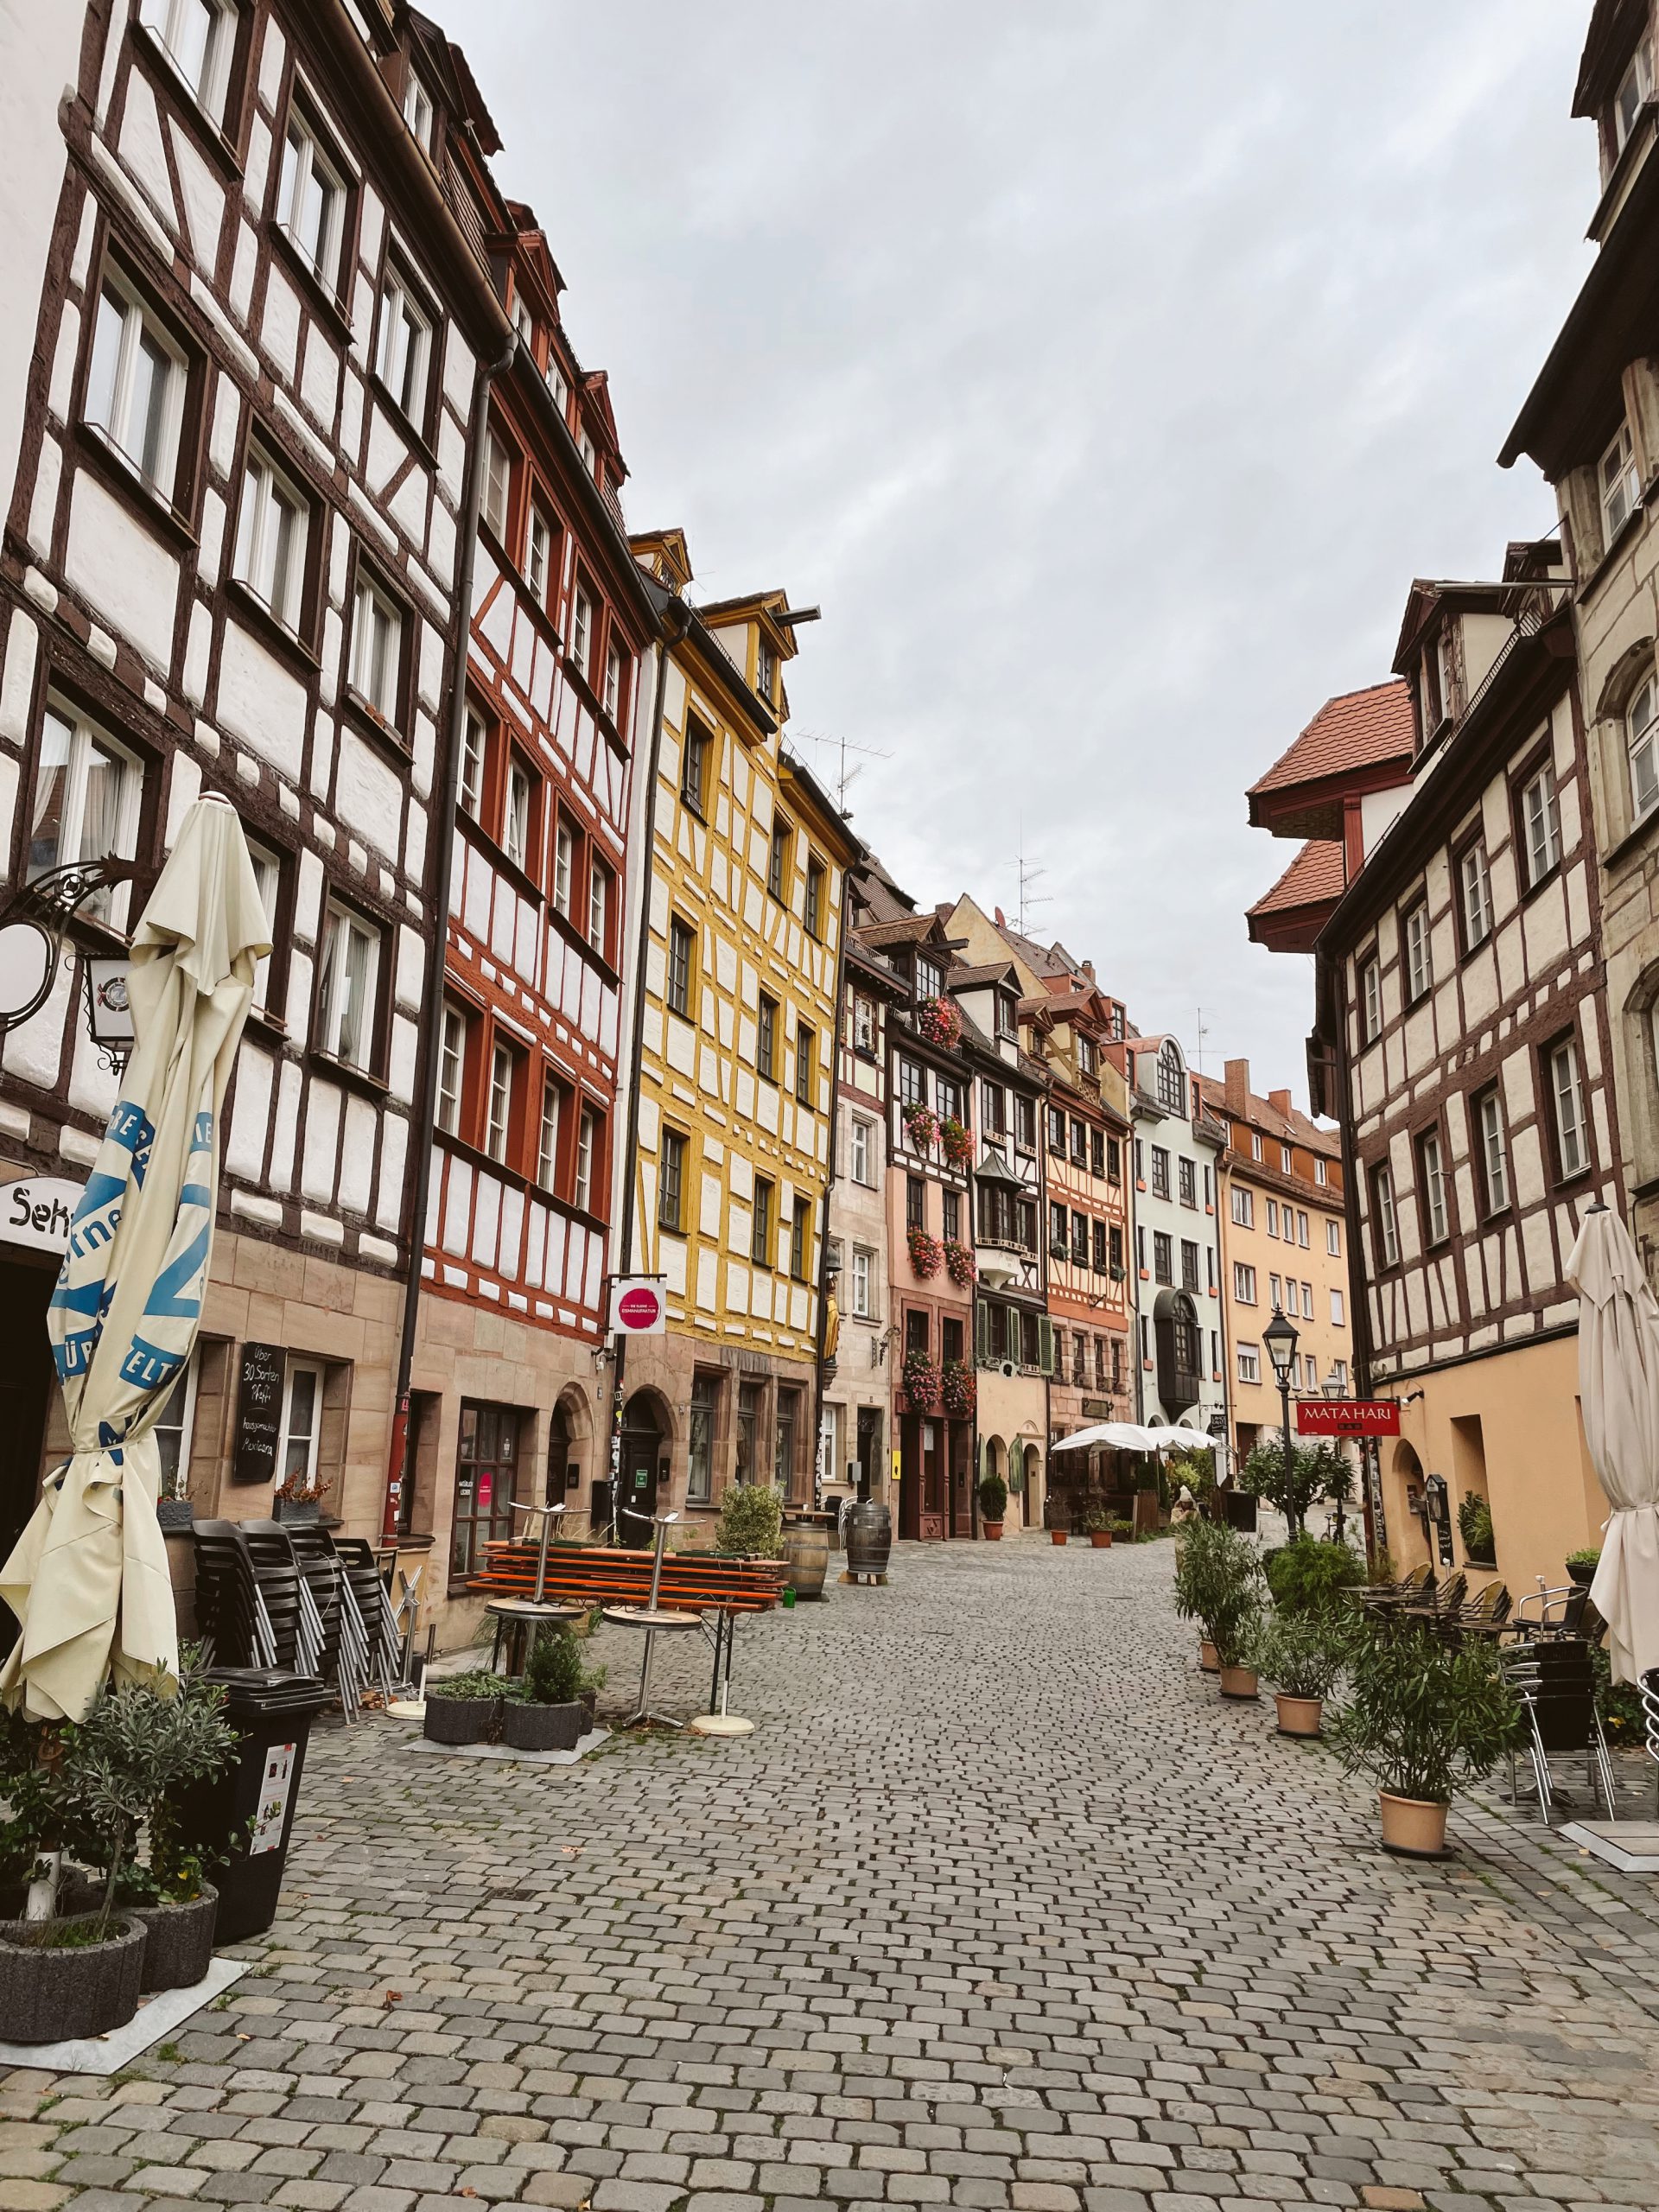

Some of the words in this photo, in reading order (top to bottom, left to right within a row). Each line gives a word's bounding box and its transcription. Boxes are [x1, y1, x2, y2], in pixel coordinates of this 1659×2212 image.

[9, 1186, 74, 1238] Sek
[254, 1345, 272, 1362] Über
[243, 1362, 256, 1382] 30
[255, 1364, 280, 1384] Sorten
[1304, 1408, 1351, 1420] MATA
[1353, 1408, 1391, 1420] HARI
